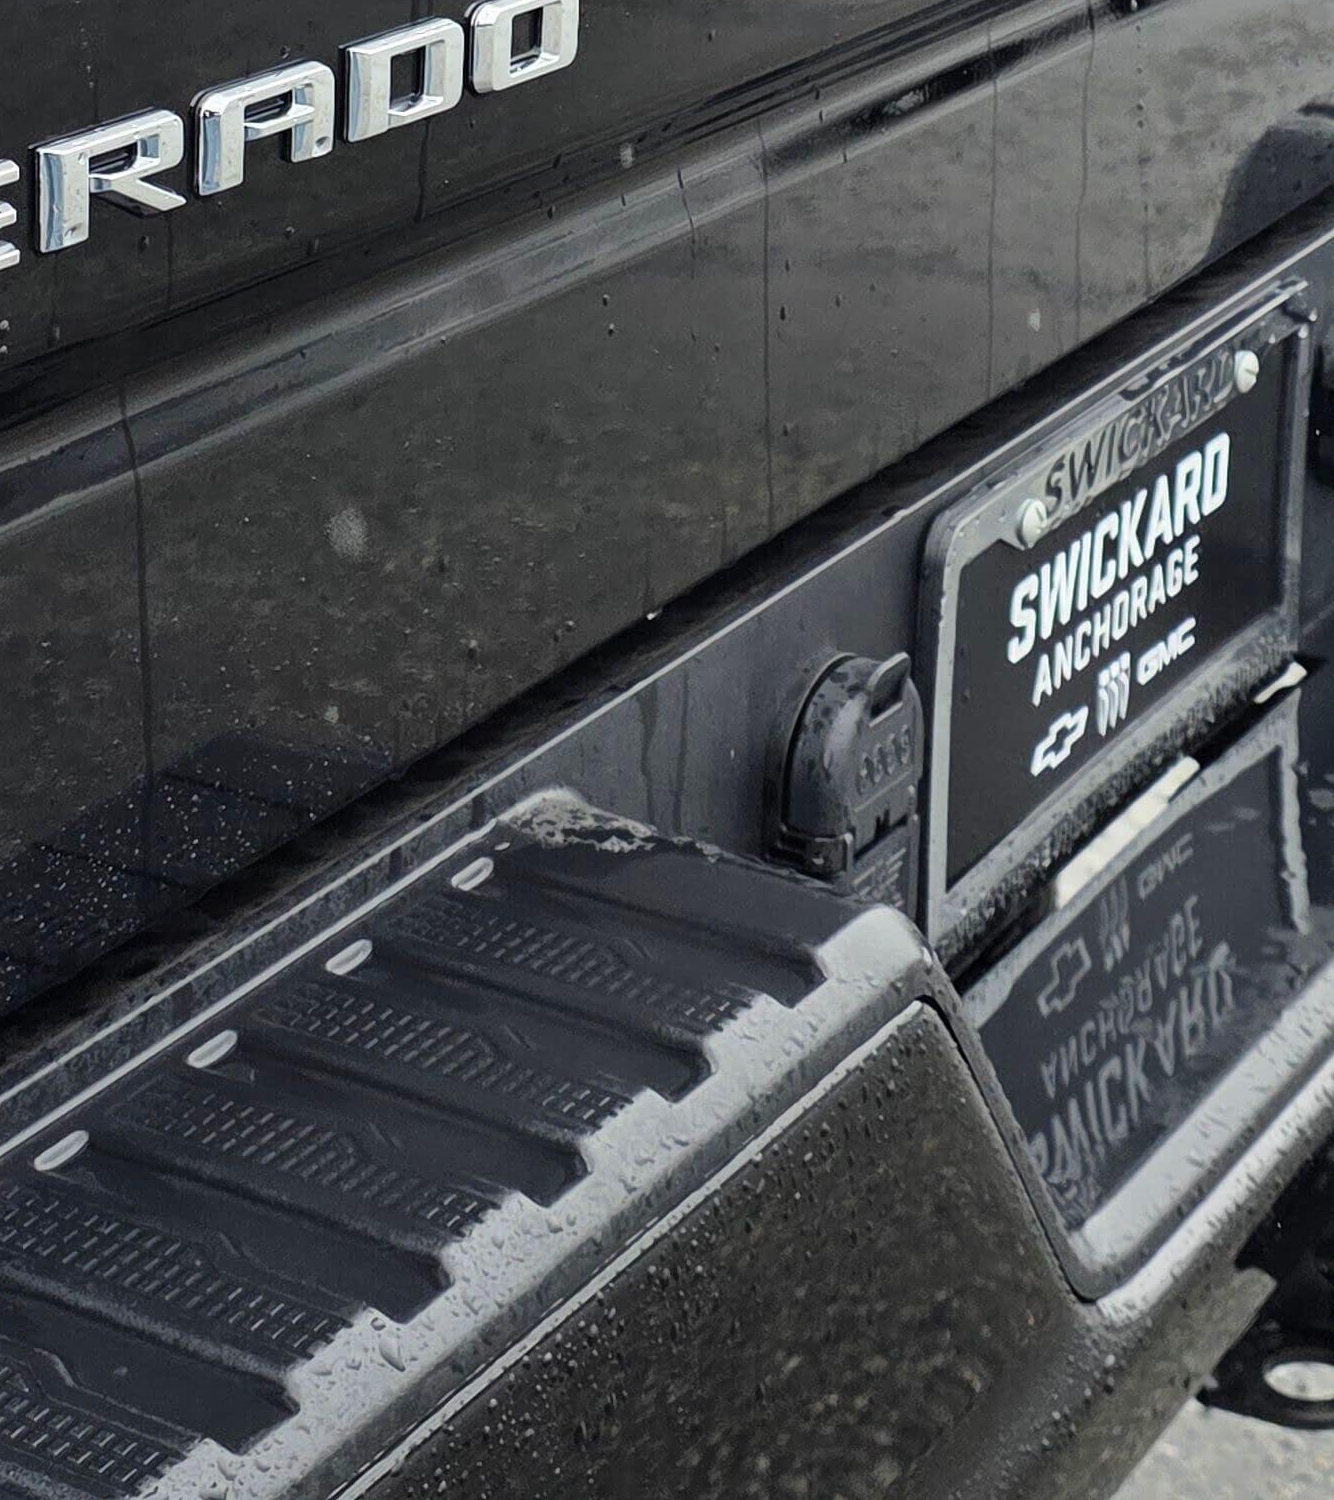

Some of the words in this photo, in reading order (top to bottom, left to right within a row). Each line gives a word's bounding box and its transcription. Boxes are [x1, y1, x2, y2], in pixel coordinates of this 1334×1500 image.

[1043, 348, 1235, 522] SWICKARD
[1006, 430, 1232, 665] SWICKARD
[1031, 534, 1202, 707] ANCHORAGE
[1135, 617, 1196, 686] GMC
